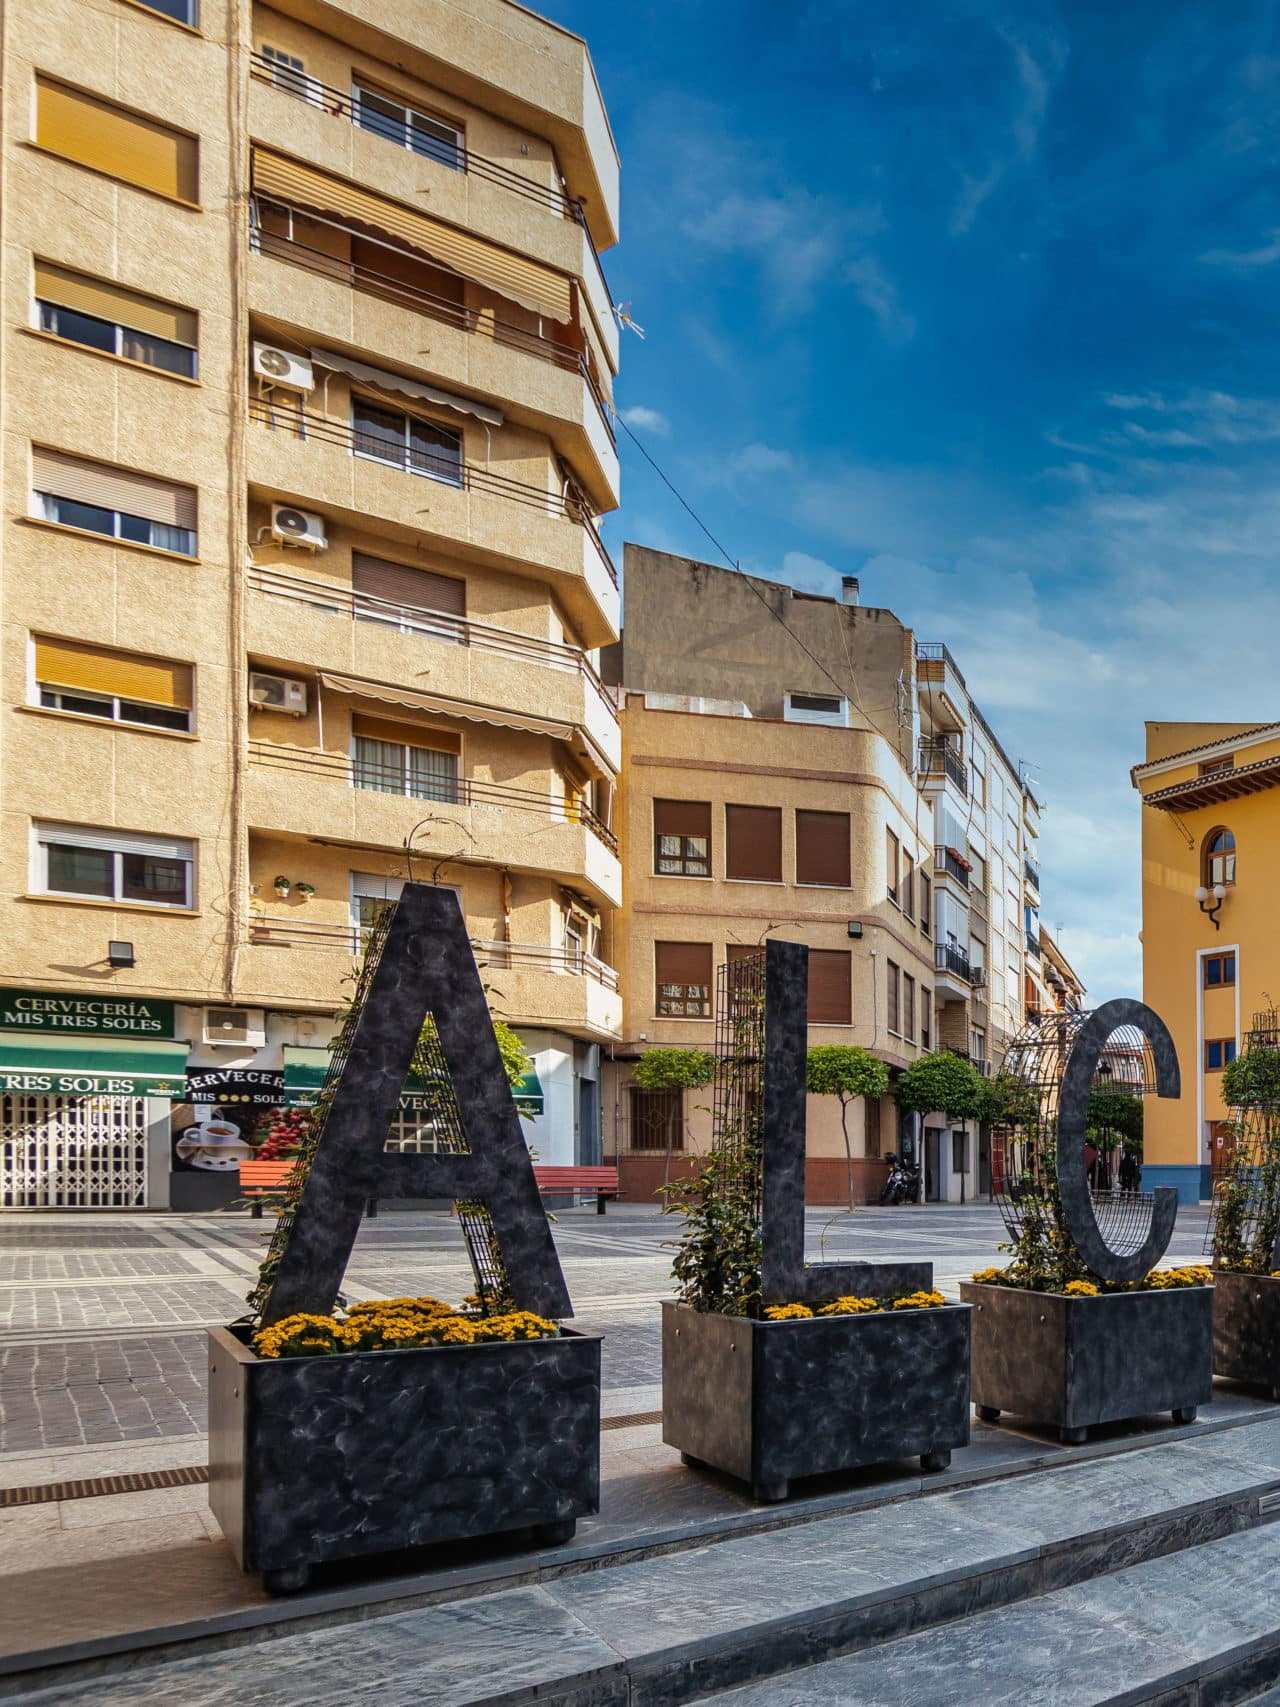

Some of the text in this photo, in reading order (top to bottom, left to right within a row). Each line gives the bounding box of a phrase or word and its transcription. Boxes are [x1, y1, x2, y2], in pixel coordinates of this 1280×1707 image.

[15, 997, 152, 1018] CERVECERÍA
[4, 1011, 162, 1032] MIS TRES SOLES
[59, 1077, 134, 1093] SOLES
[192, 1092, 216, 1102] MIS
